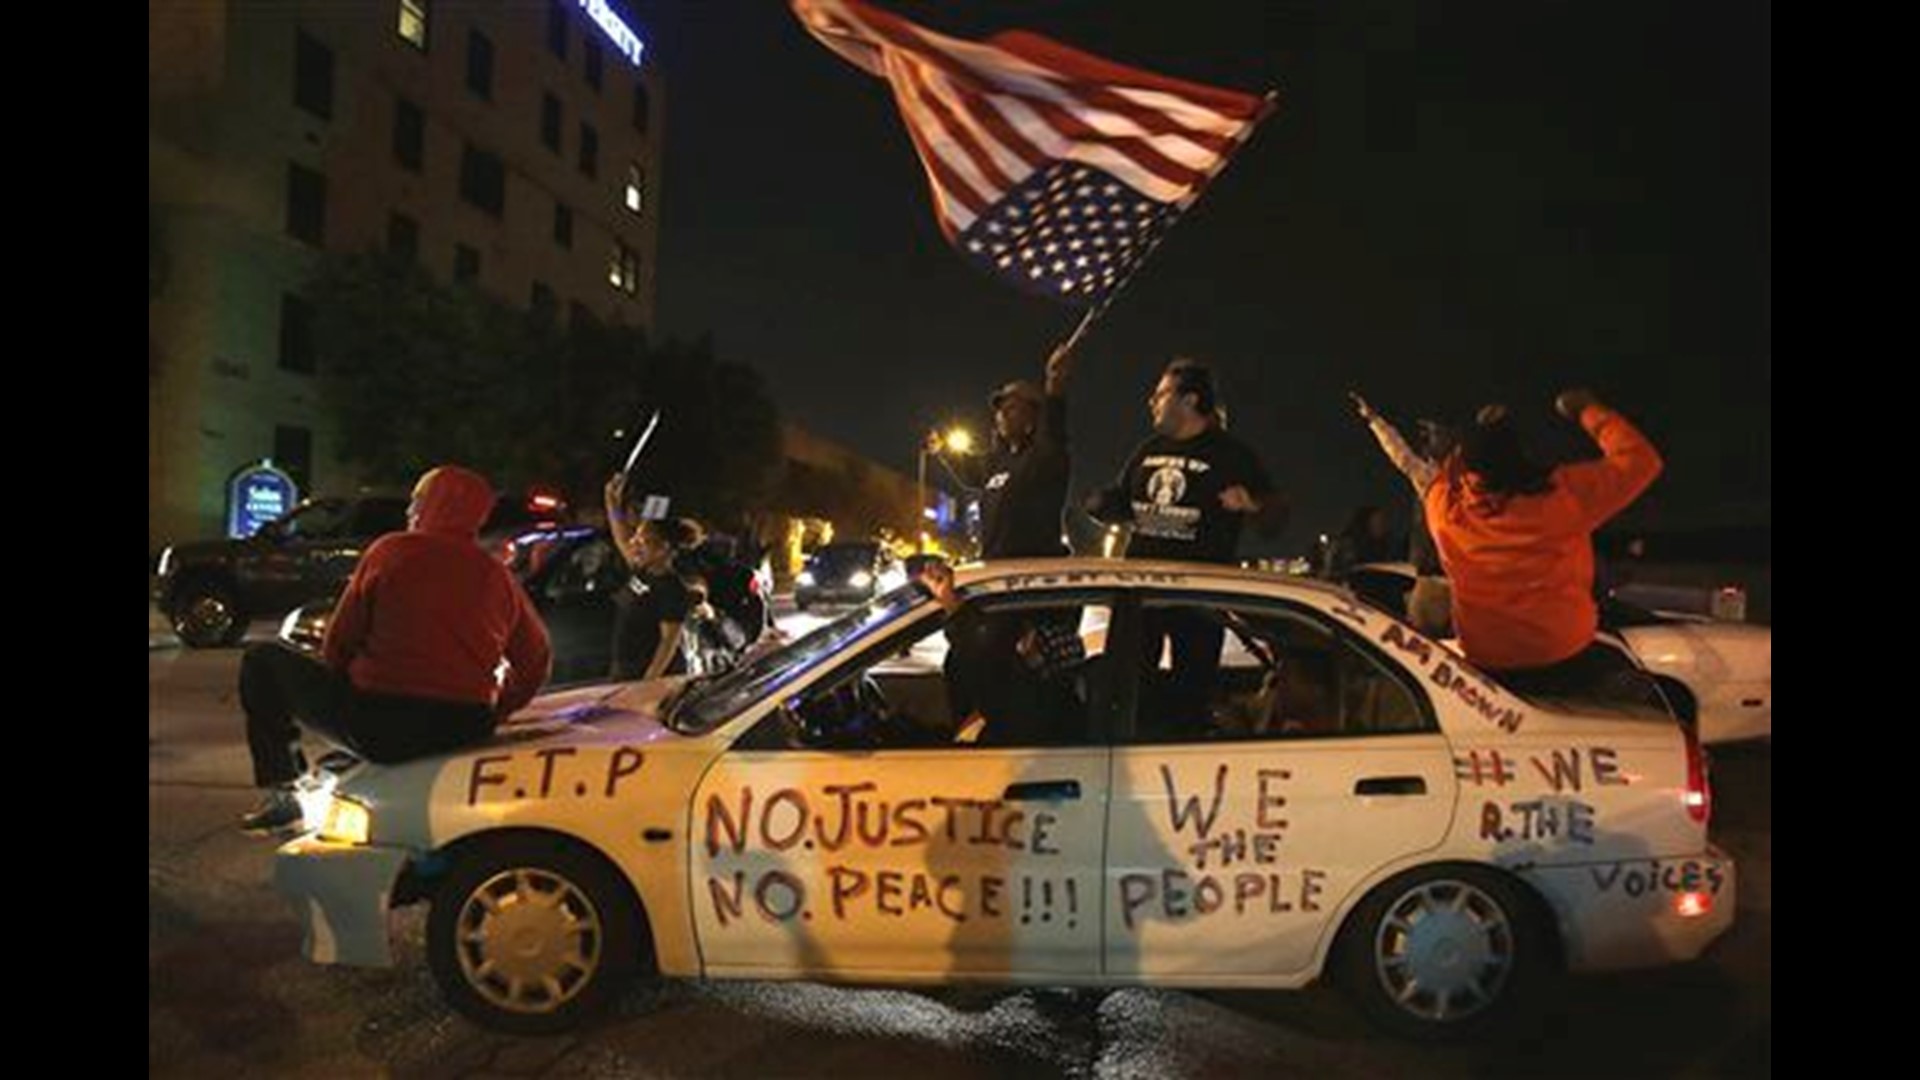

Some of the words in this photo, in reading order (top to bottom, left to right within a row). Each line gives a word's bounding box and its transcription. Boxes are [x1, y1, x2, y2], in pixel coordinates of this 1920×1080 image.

[1381, 622, 1432, 666] AM
[1429, 661, 1525, 735] BROWN
[1160, 763, 1291, 839] WE
[1530, 748, 1630, 792] WE
[1188, 829, 1282, 870] THE
[1119, 868, 1327, 930] PEOPLE
